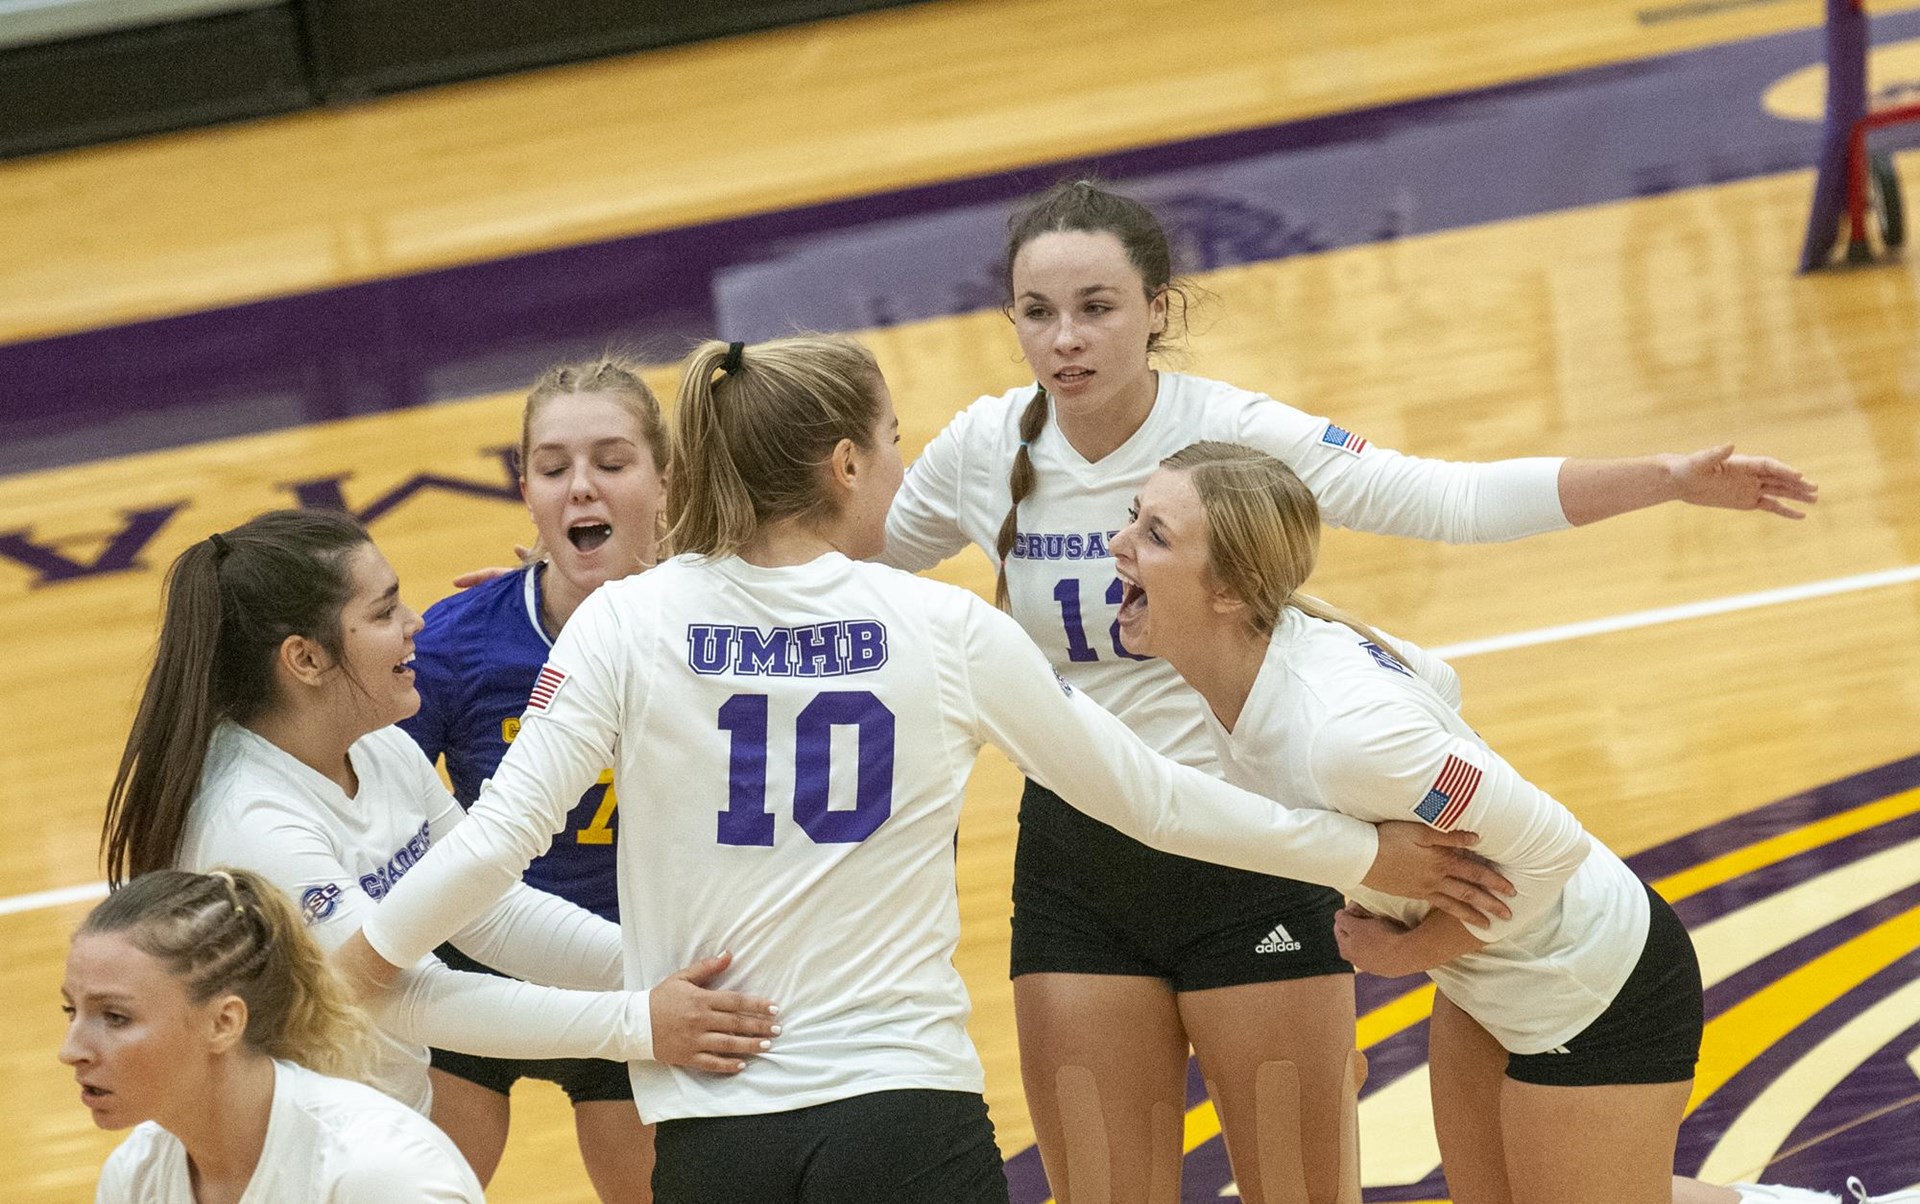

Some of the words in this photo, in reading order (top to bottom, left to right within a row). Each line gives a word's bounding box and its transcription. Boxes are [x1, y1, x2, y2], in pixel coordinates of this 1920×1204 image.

[687, 619, 888, 677] UMHB
[717, 691, 895, 846] 10
[1255, 941, 1301, 953] adidas
